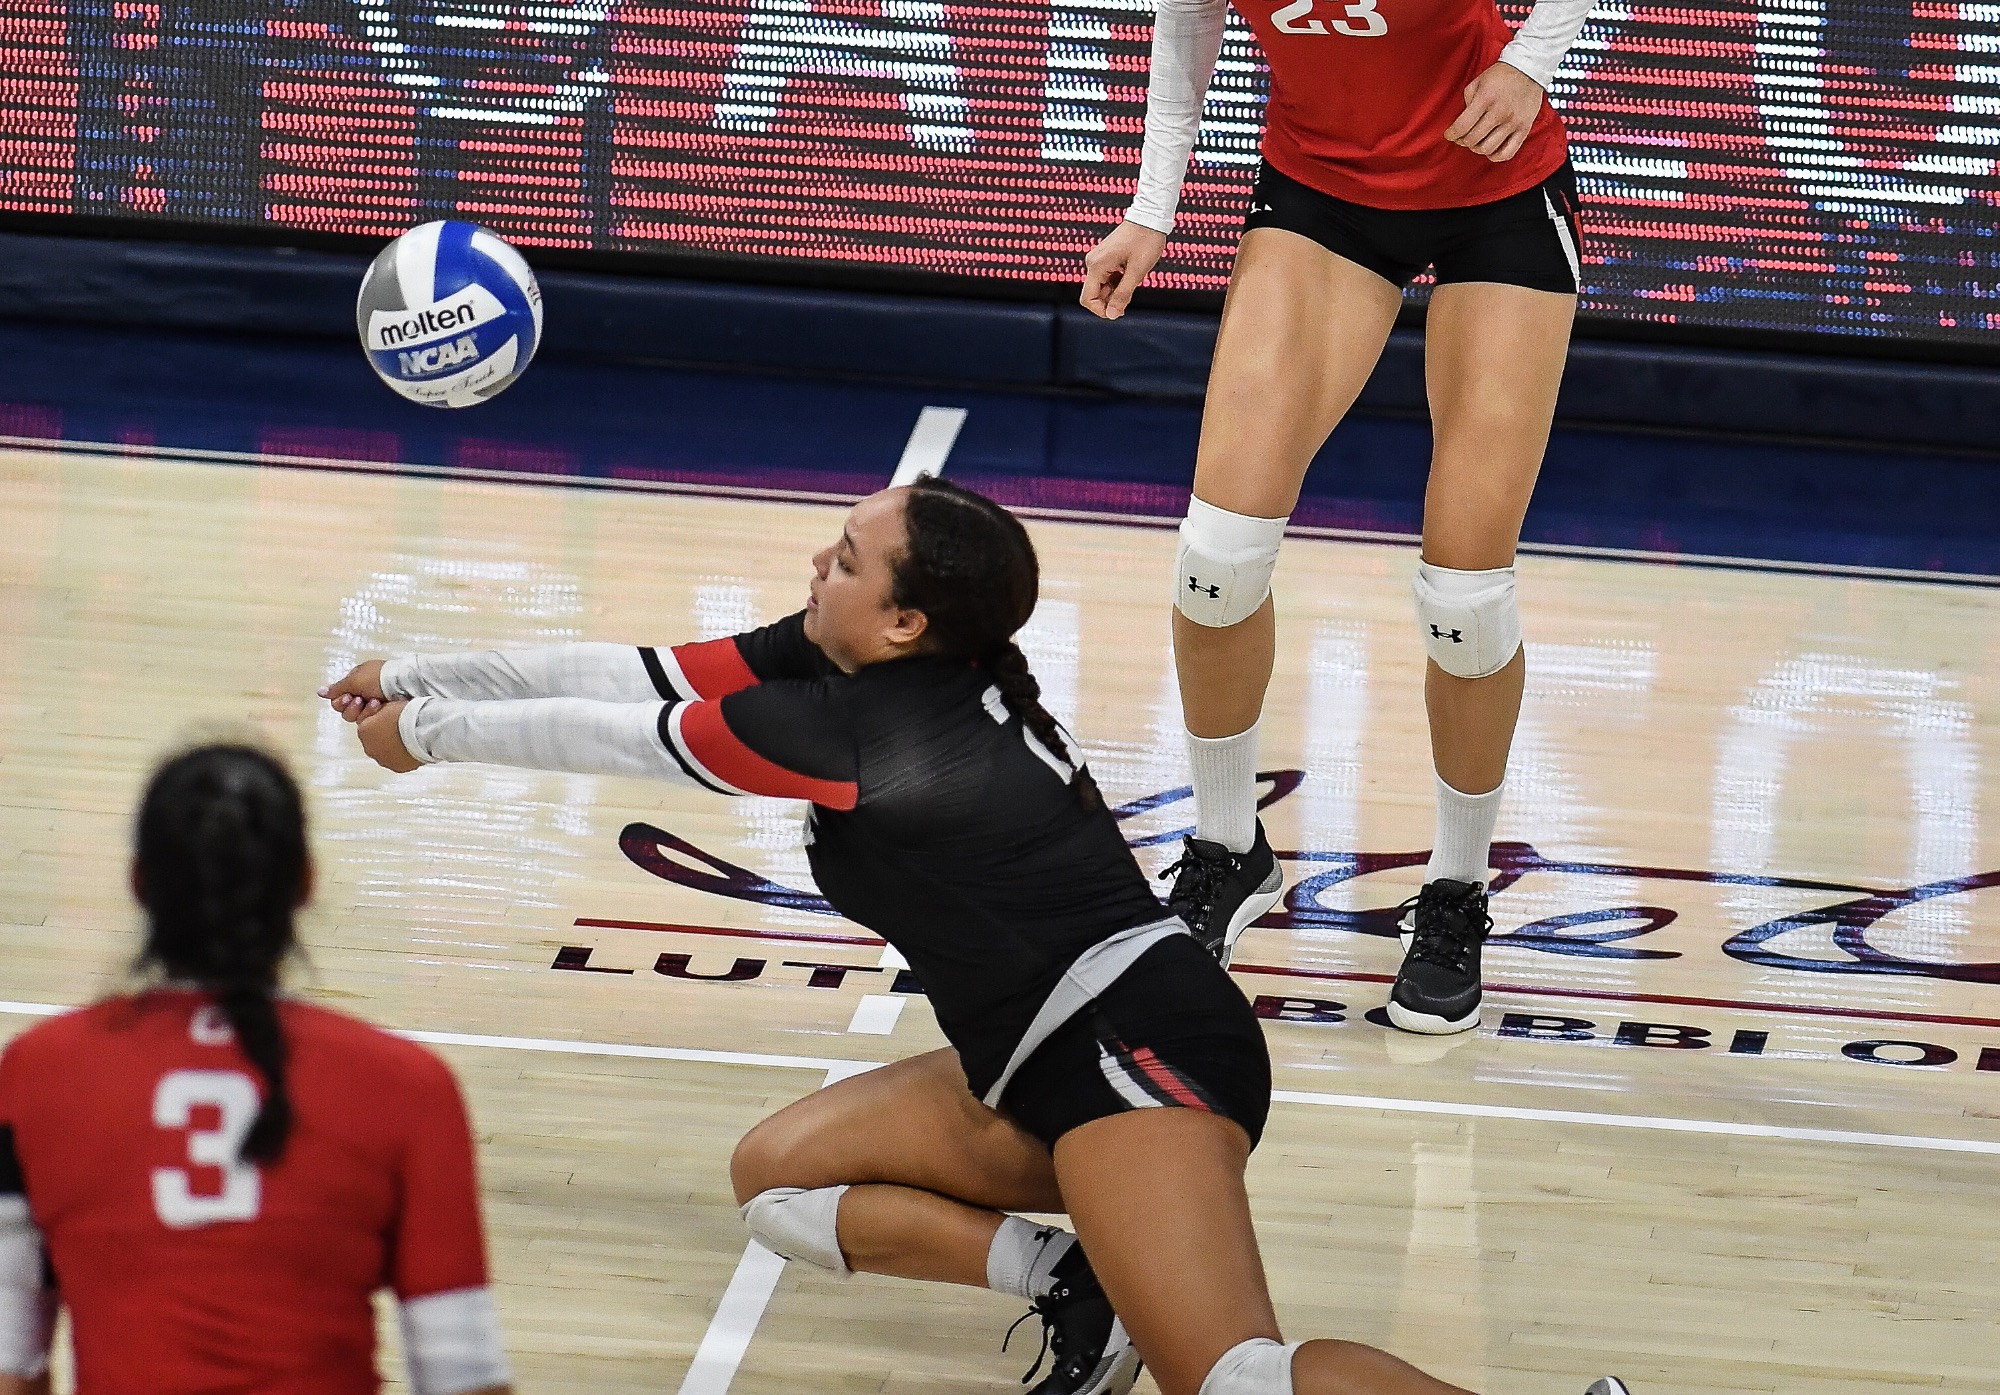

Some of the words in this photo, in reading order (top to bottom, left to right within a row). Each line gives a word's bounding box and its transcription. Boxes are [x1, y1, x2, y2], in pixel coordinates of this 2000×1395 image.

[1270, 0, 1388, 36] 23
[381, 304, 476, 346] molten
[397, 336, 480, 376] NCAA
[1253, 995, 1769, 1055] BBBI
[152, 1069, 262, 1229] 3
